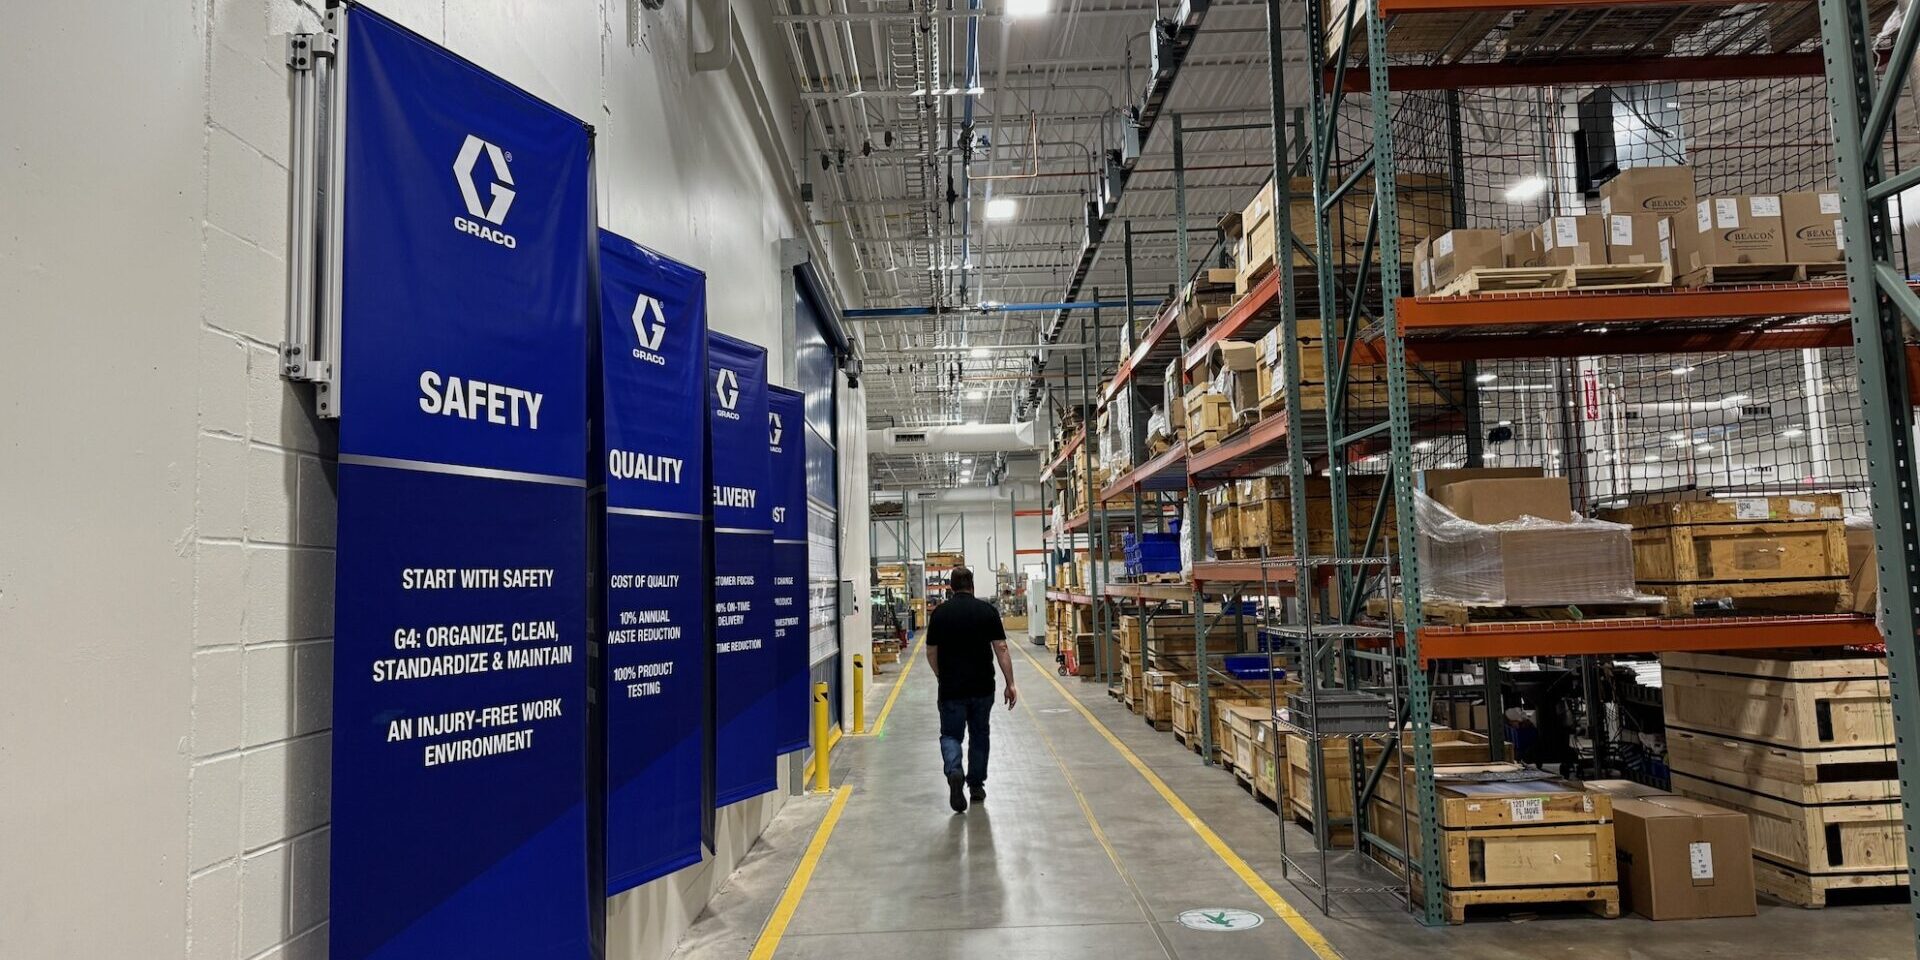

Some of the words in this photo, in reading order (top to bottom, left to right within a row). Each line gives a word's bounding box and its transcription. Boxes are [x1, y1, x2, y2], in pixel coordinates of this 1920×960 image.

[455, 217, 516, 249] GRACO
[1734, 231, 1774, 241] BEACON
[1806, 228, 1837, 239] BEAC
[633, 348, 666, 366] GRACO
[419, 370, 543, 430] SAFETY
[716, 409, 740, 421] GRACO
[609, 448, 683, 484] QUALITY
[713, 485, 756, 509] ELIVERY
[772, 506, 786, 523] ST
[402, 568, 457, 590] START
[461, 569, 499, 589] WITH
[502, 569, 554, 588] SAFETY
[610, 574, 634, 589] COST
[635, 574, 646, 588] OF
[647, 574, 680, 588] QUALITY
[737, 575, 755, 586] FOCUS
[727, 601, 751, 612] ON-TIME
[620, 611, 637, 625] 10%
[638, 609, 671, 624] ANNUAL
[718, 614, 744, 627] DELIVERY
[394, 628, 421, 650] G4:
[426, 623, 508, 648] ORGANIZE,
[511, 620, 559, 642] CLEAN,
[637, 626, 681, 642] REDUCTION
[731, 638, 762, 652] REDUCTION
[373, 652, 489, 682] STANDARDIZE
[492, 651, 503, 671] &
[507, 645, 573, 670] MAINTAIN
[613, 665, 636, 682] 100%
[637, 661, 674, 679] PRODUCT
[627, 680, 661, 698] TESTING
[387, 718, 412, 743] AN
[417, 703, 518, 738] INJURY-FREE
[521, 697, 562, 722] WORK
[424, 729, 534, 767] ENVIRONMENT
